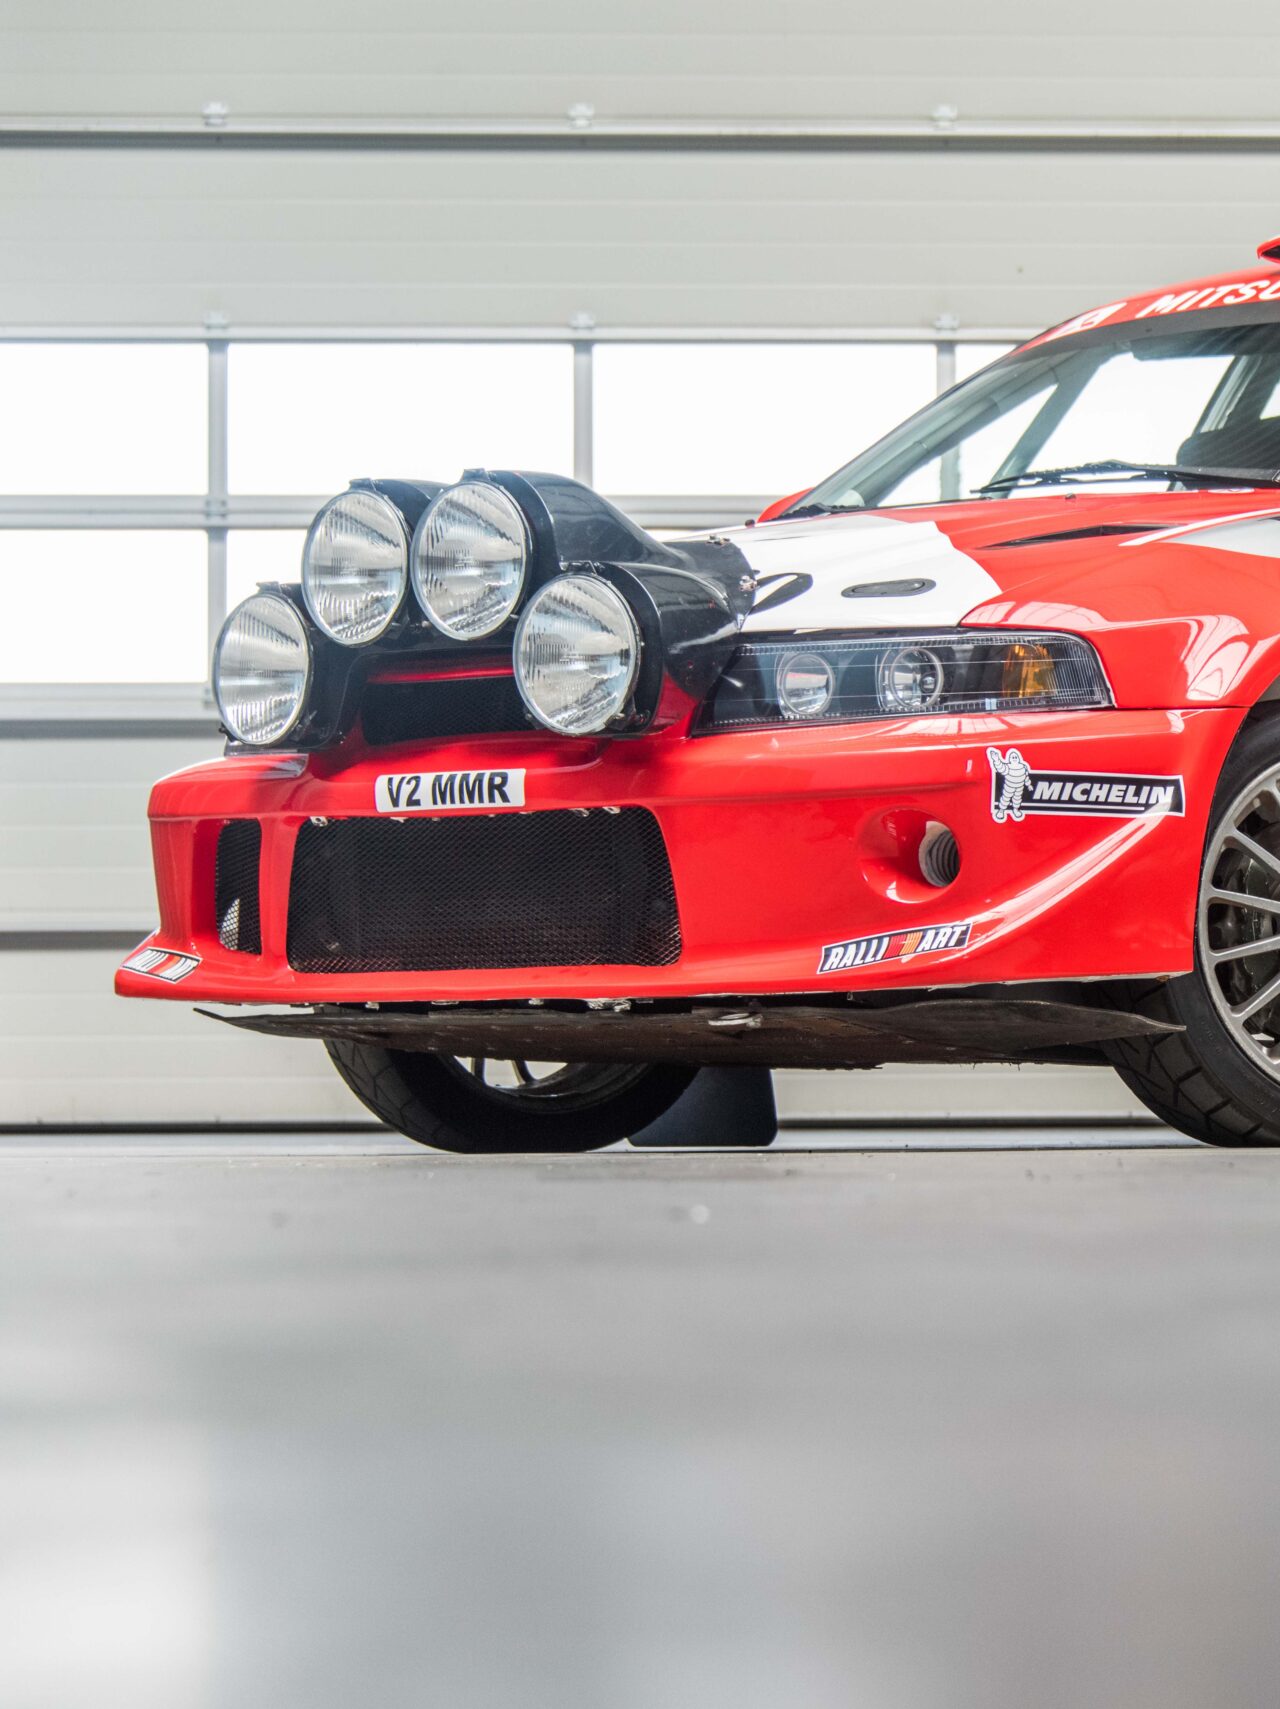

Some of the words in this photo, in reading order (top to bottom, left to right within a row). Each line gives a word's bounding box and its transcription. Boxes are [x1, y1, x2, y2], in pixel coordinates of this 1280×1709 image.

[387, 775, 422, 808] V2
[431, 771, 511, 806] MMR
[1032, 781, 1175, 805] MICHELIN
[823, 937, 890, 971] RALLI
[916, 925, 968, 952] ART
